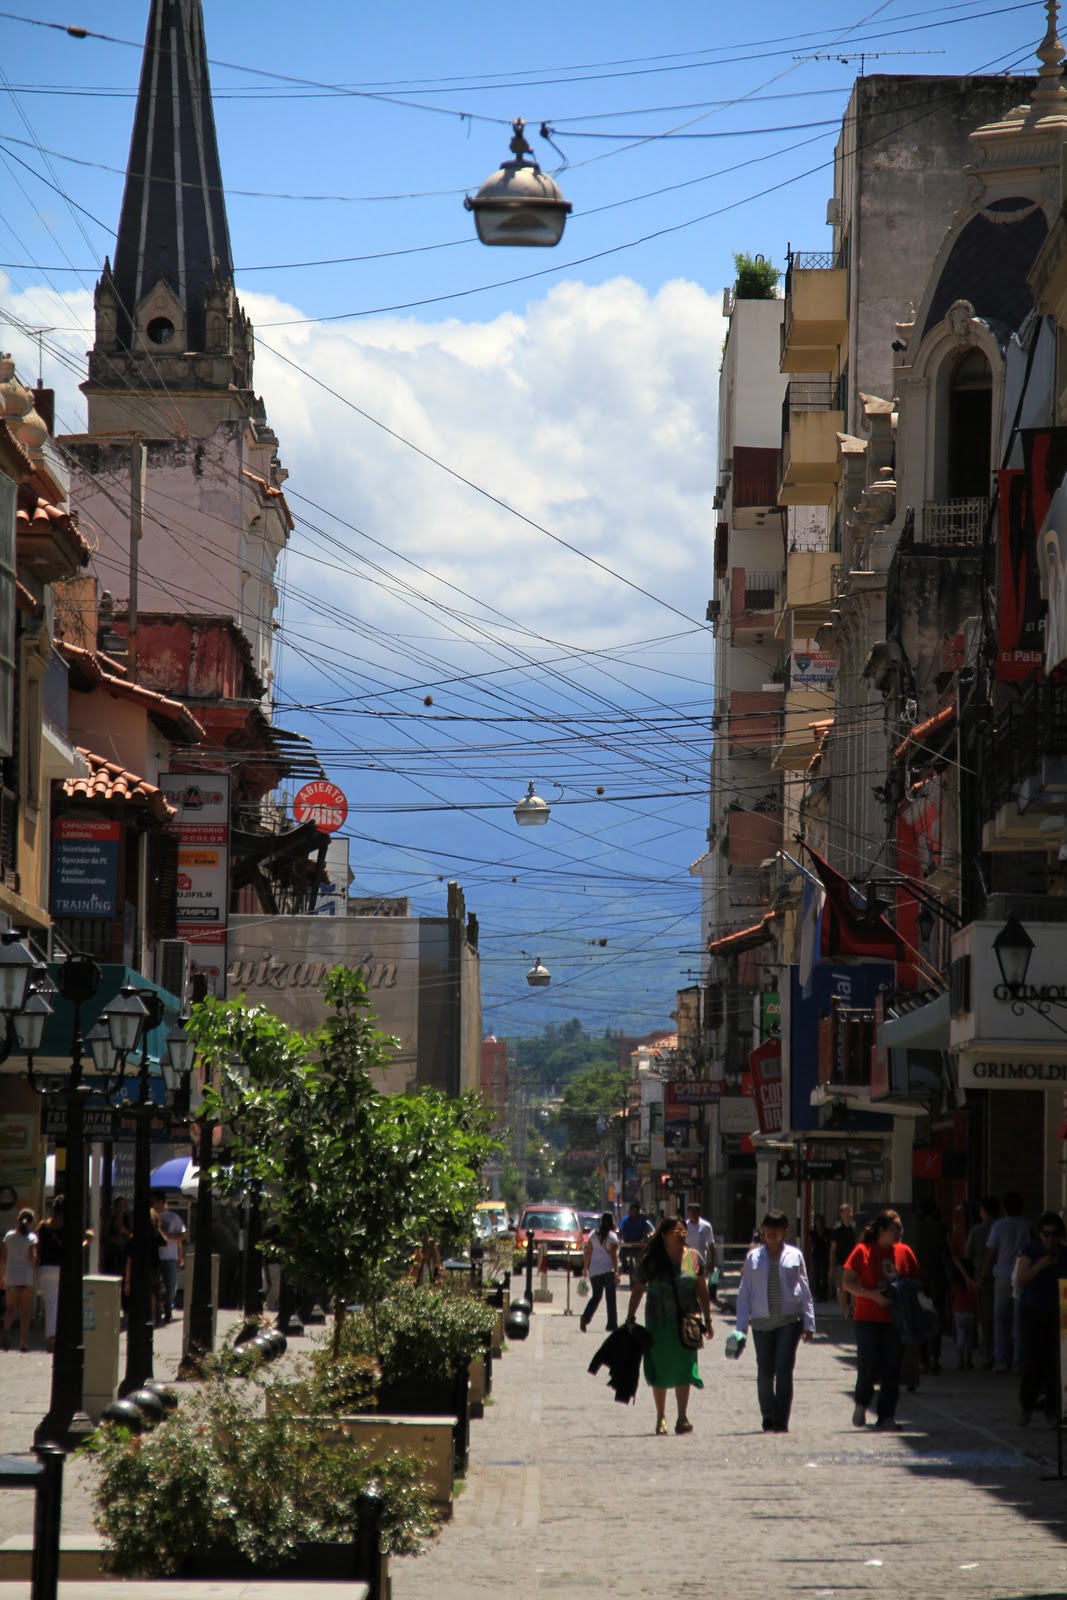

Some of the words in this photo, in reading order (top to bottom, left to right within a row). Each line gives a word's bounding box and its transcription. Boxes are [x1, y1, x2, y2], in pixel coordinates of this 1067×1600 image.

[1015, 650, 1042, 662] Pala
[300, 782, 344, 804] ABIERTO
[62, 845, 101, 853] Secretariado
[61, 856, 90, 864] Operador
[99, 857, 108, 865] PC
[61, 868, 86, 876] Auxiliar
[61, 877, 107, 885] Administrativo
[176, 891, 213, 899] UJIFILM
[56, 899, 111, 911] TRAINING
